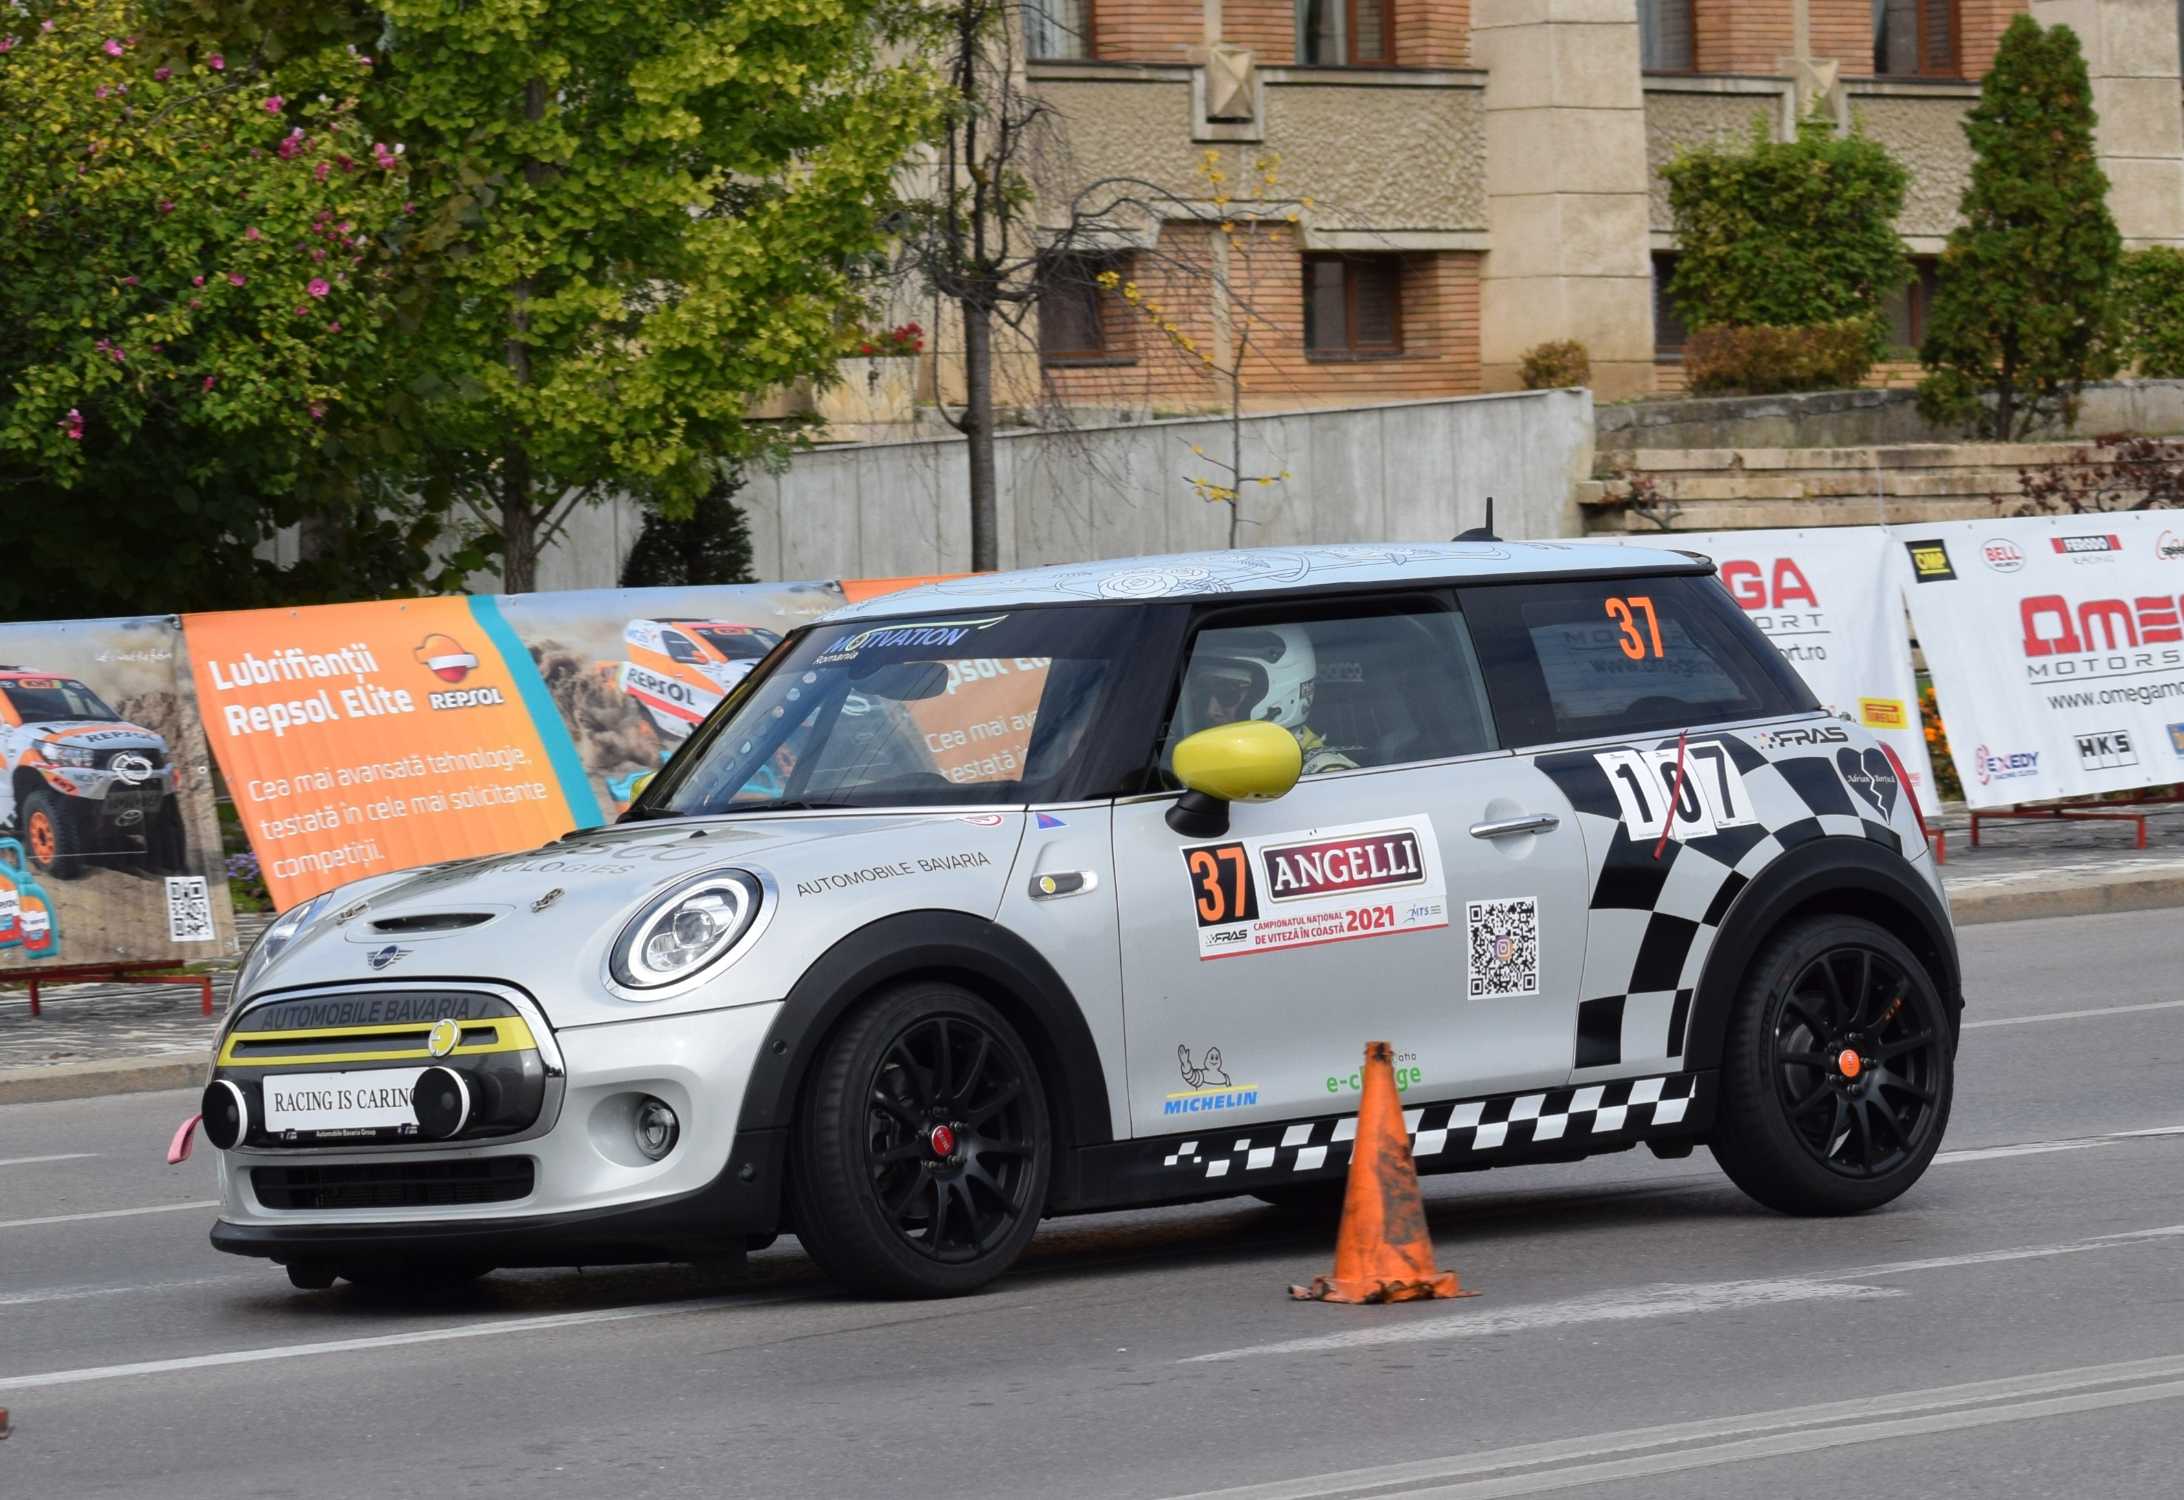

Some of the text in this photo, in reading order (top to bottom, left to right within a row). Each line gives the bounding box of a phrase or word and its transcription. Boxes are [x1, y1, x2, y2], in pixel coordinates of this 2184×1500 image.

[1914, 552, 1946, 570] OMP
[1984, 546, 2023, 562] BELL
[822, 627, 969, 654] MOTIVATION
[1604, 596, 1665, 661] 37
[207, 642, 380, 690] Lubrifianții
[428, 687, 505, 711] REPSOL
[627, 667, 696, 706] REPSOL
[223, 683, 416, 737] Repsol Elite
[924, 727, 969, 753] Cea
[969, 715, 1010, 742] mai
[1772, 726, 1849, 748] FRAS
[2078, 734, 2132, 758] HKS
[1987, 752, 2040, 772] EXEDY
[247, 779, 292, 803] Cea
[294, 767, 336, 794] mai
[337, 755, 426, 787] avansată
[260, 804, 341, 841] testată
[366, 796, 409, 822] cele
[410, 790, 449, 816] mai
[451, 780, 549, 810] solicitante
[795, 850, 992, 897] AUTOMOBILE BAVARIA
[1190, 839, 1420, 922] 37 ANGELLI
[1253, 917, 1306, 932] CAMPIONATUL
[1345, 905, 1395, 932] 2021
[1214, 929, 1248, 944] FRAS
[1255, 935, 1267, 945] DE
[1267, 928, 1299, 944] VITEZĂ
[1311, 922, 1345, 939] COASTĂ
[262, 998, 469, 1030] AUTOMOBILE BAVARIA
[274, 1090, 333, 1112] RACING
[337, 1089, 353, 1110] IS
[1164, 1091, 1258, 1115] MICHELIN
